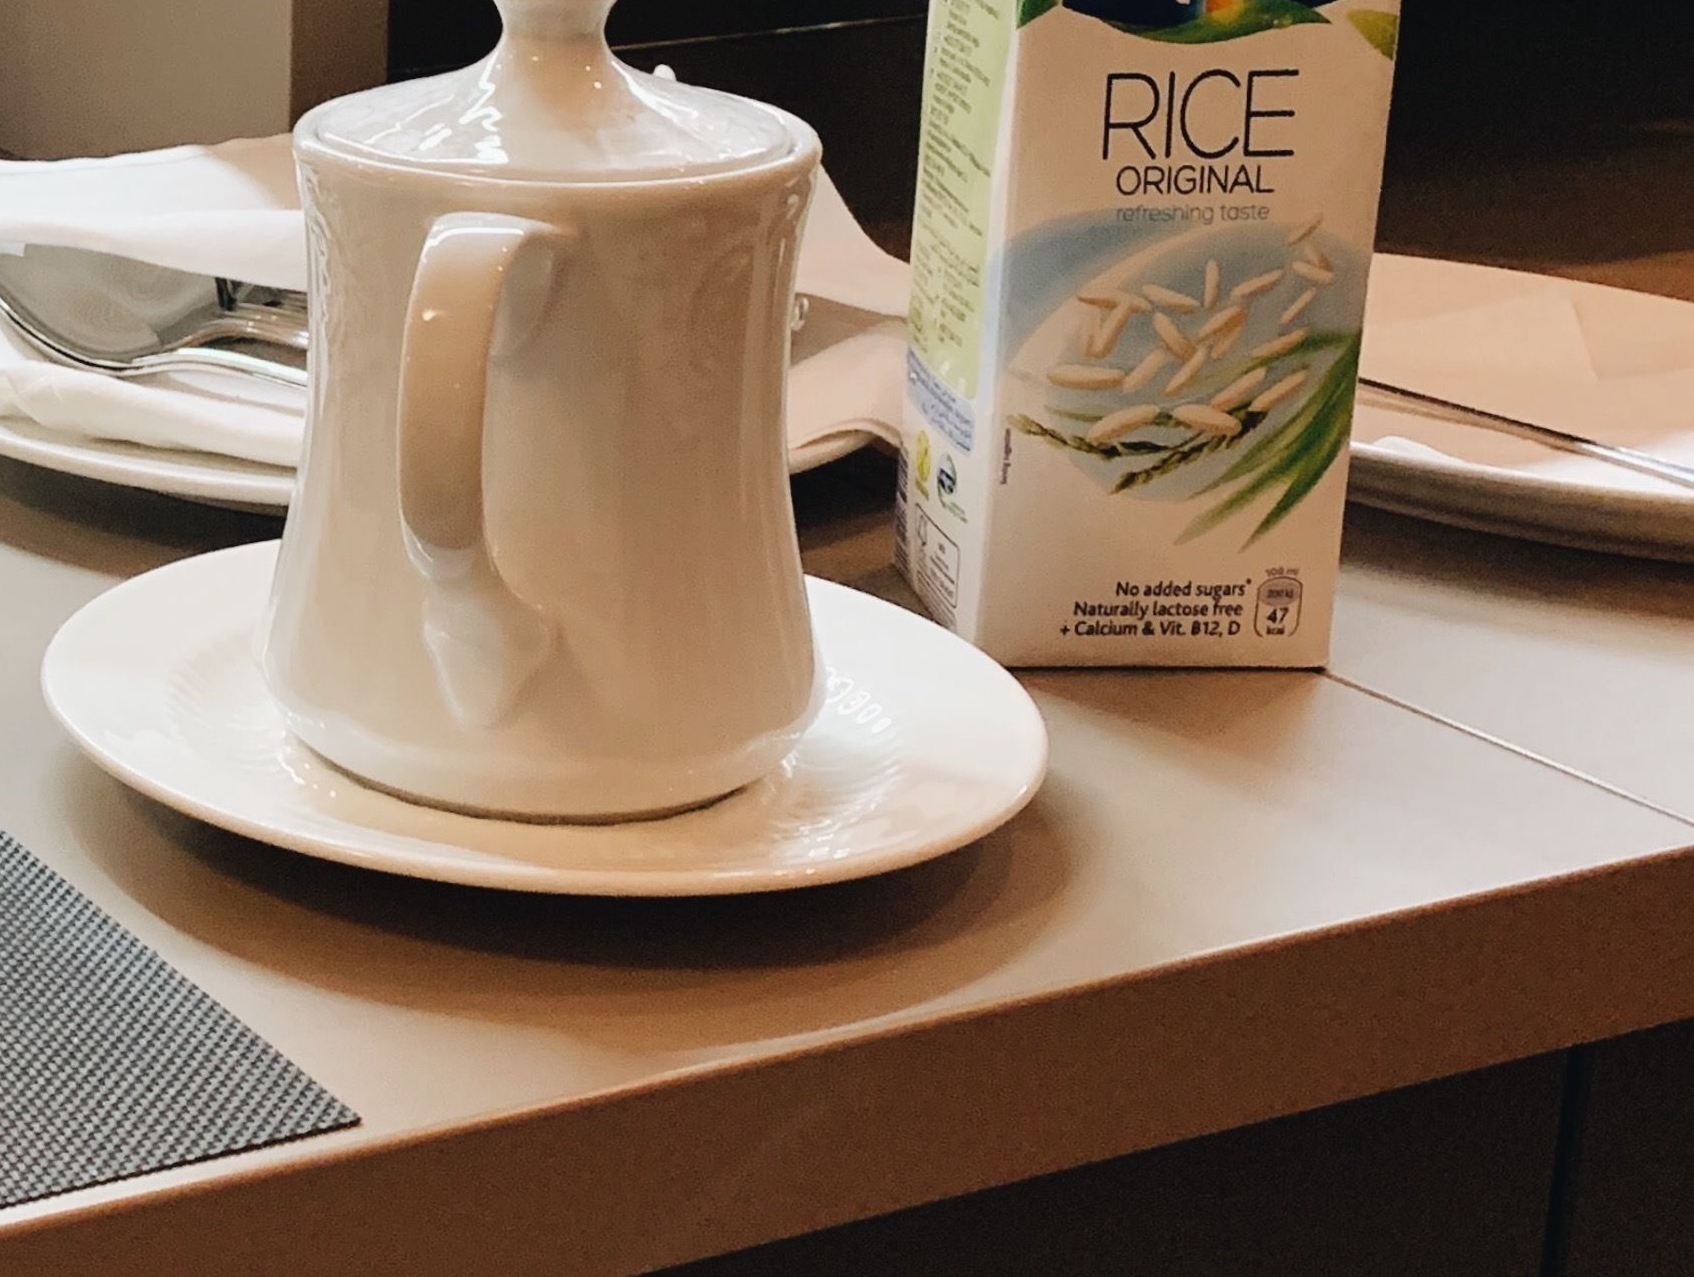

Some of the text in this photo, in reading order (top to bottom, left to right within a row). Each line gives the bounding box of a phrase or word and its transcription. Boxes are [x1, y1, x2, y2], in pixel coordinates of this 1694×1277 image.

[1102, 69, 1300, 160] RICE
[1116, 164, 1275, 196] ORIGINAL
[1115, 204, 1270, 225] refreshing taste
[1115, 581, 1140, 597] No
[1143, 580, 1192, 597] added
[1073, 601, 1243, 620] Naturally lactose free
[1266, 607, 1289, 624] 47
[1074, 620, 1138, 636] Calcium
[1142, 620, 1155, 636] &
[1160, 620, 1186, 636] Vit.
[1228, 620, 1241, 636] D
